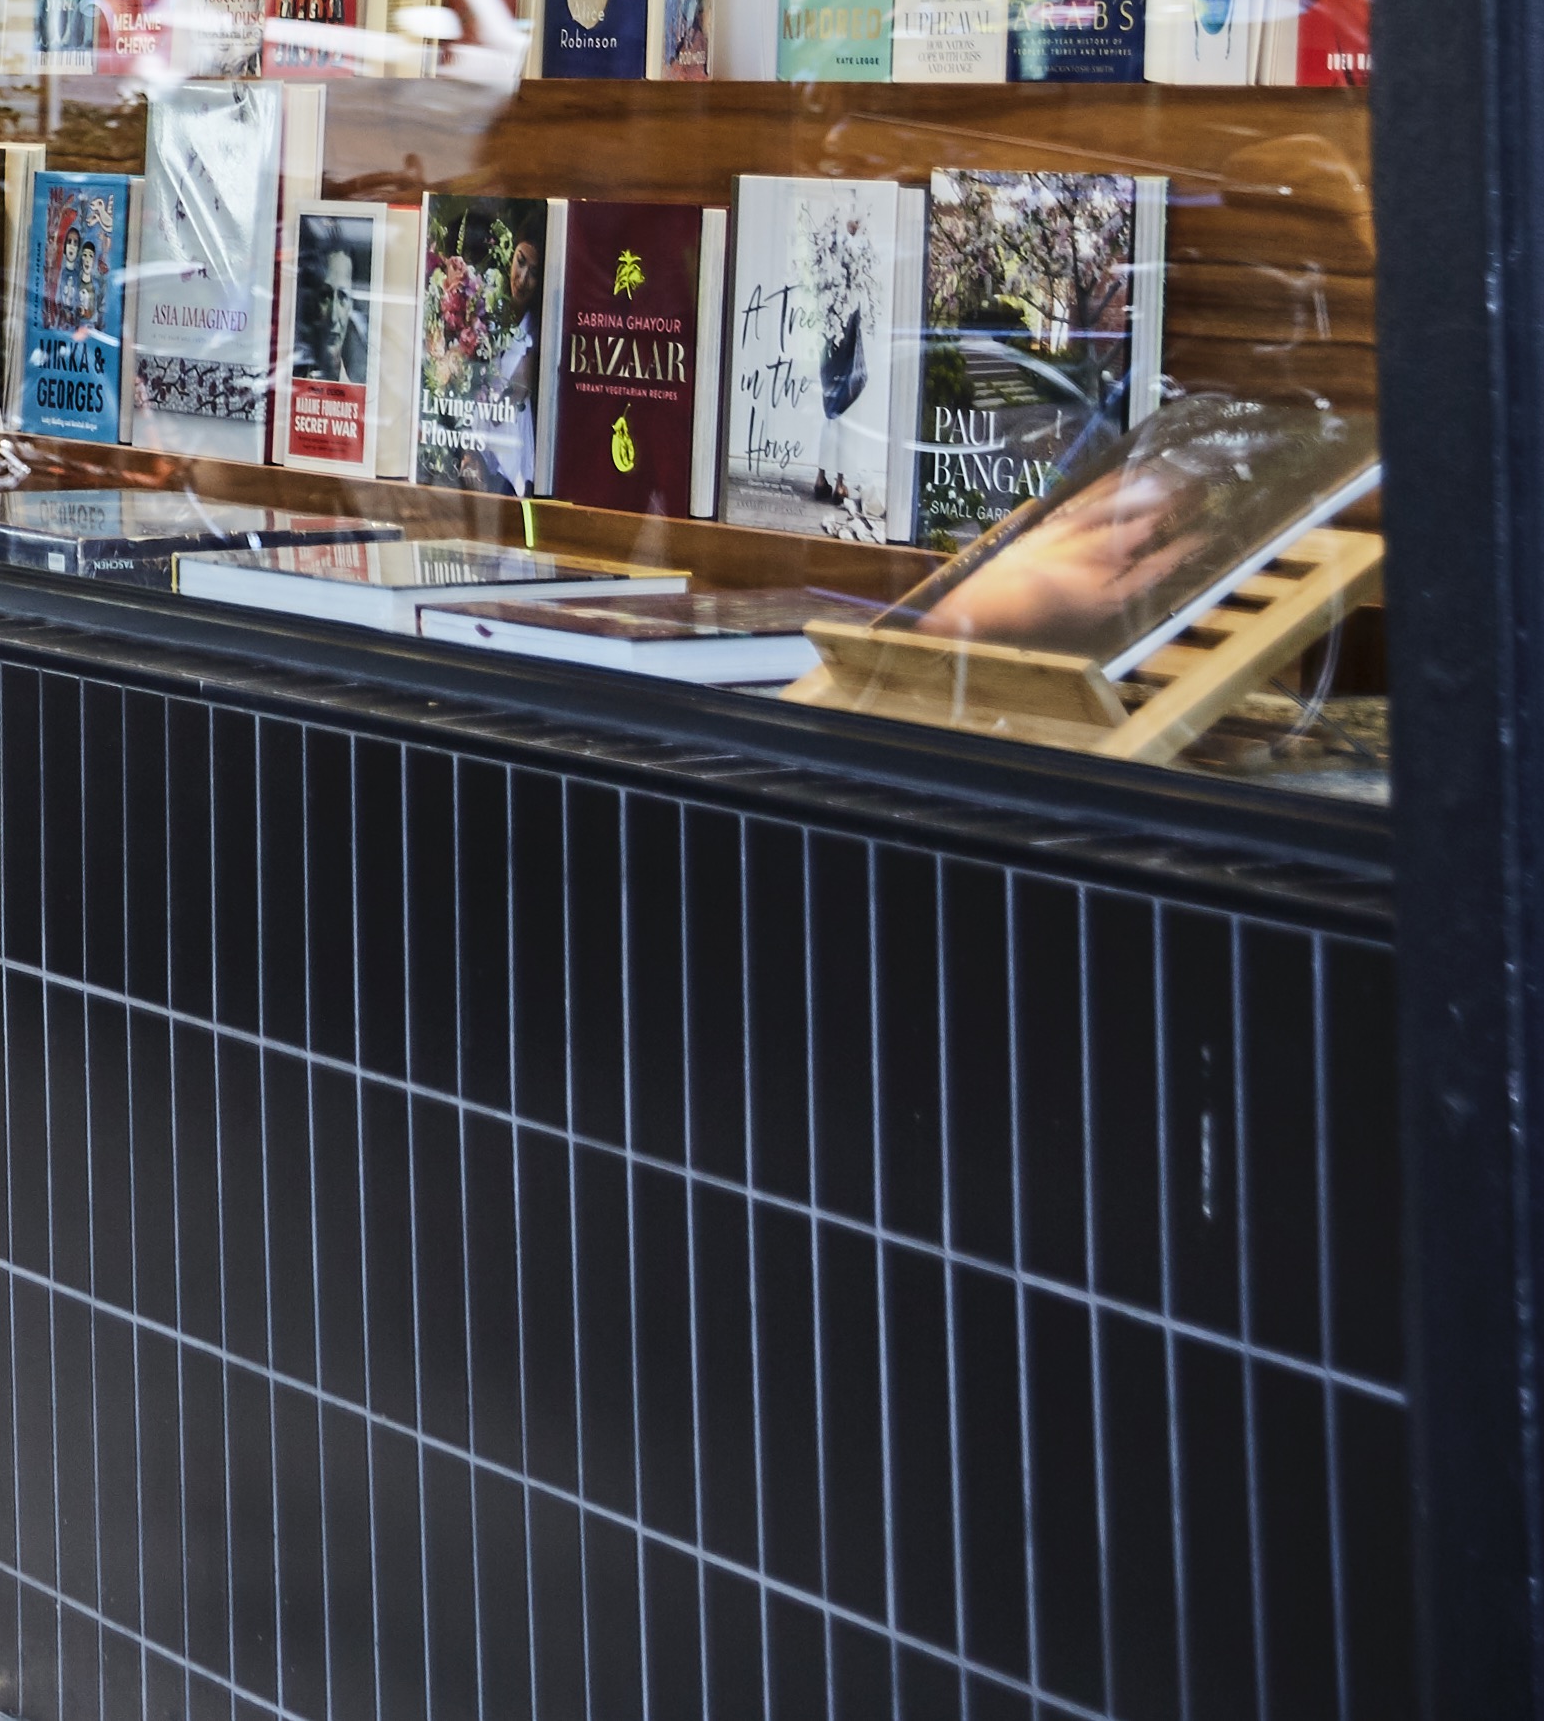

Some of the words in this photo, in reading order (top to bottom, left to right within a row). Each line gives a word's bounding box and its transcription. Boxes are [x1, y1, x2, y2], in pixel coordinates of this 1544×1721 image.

[113, 13, 161, 31] MELANIE
[573, 3, 605, 22] Alice
[783, 7, 882, 41] KINDRED
[903, 10, 996, 36] UPHEAVAL
[1013, 0, 1135, 32] ARABS
[116, 37, 156, 55] CHENG
[560, 28, 617, 49] Robinson
[926, 40, 943, 51] HOW
[944, 39, 975, 51] NATIONS
[918, 52, 938, 62] COPE
[938, 51, 958, 62] WITH
[928, 64, 942, 74] AND
[943, 62, 974, 74] CHANGE
[152, 304, 179, 326] ASIA
[182, 306, 248, 332] IMAGINED
[577, 311, 624, 330] SABRINA
[626, 315, 681, 334] GHAYOUR
[742, 284, 767, 350] A
[765, 284, 818, 352] Tree
[37, 339, 89, 374] MIRKA
[94, 347, 106, 374] &
[570, 334, 687, 384] BAZAAR
[37, 378, 104, 414] GEORGES
[575, 382, 604, 393] VIBRANT
[605, 384, 647, 398] VEGETARIAN
[649, 388, 678, 400] RECIPES
[741, 364, 764, 400] in
[766, 356, 810, 409] the
[422, 389, 475, 427] Living
[477, 390, 516, 424] with
[295, 415, 328, 434] SECRET
[331, 419, 357, 439] WAR
[420, 419, 486, 452] Flowers
[934, 406, 1006, 448] PAUL
[745, 406, 803, 477] House
[933, 450, 1053, 498] BANGAY
[930, 500, 971, 519] SMALL
[93, 559, 135, 570] TASCHEN
